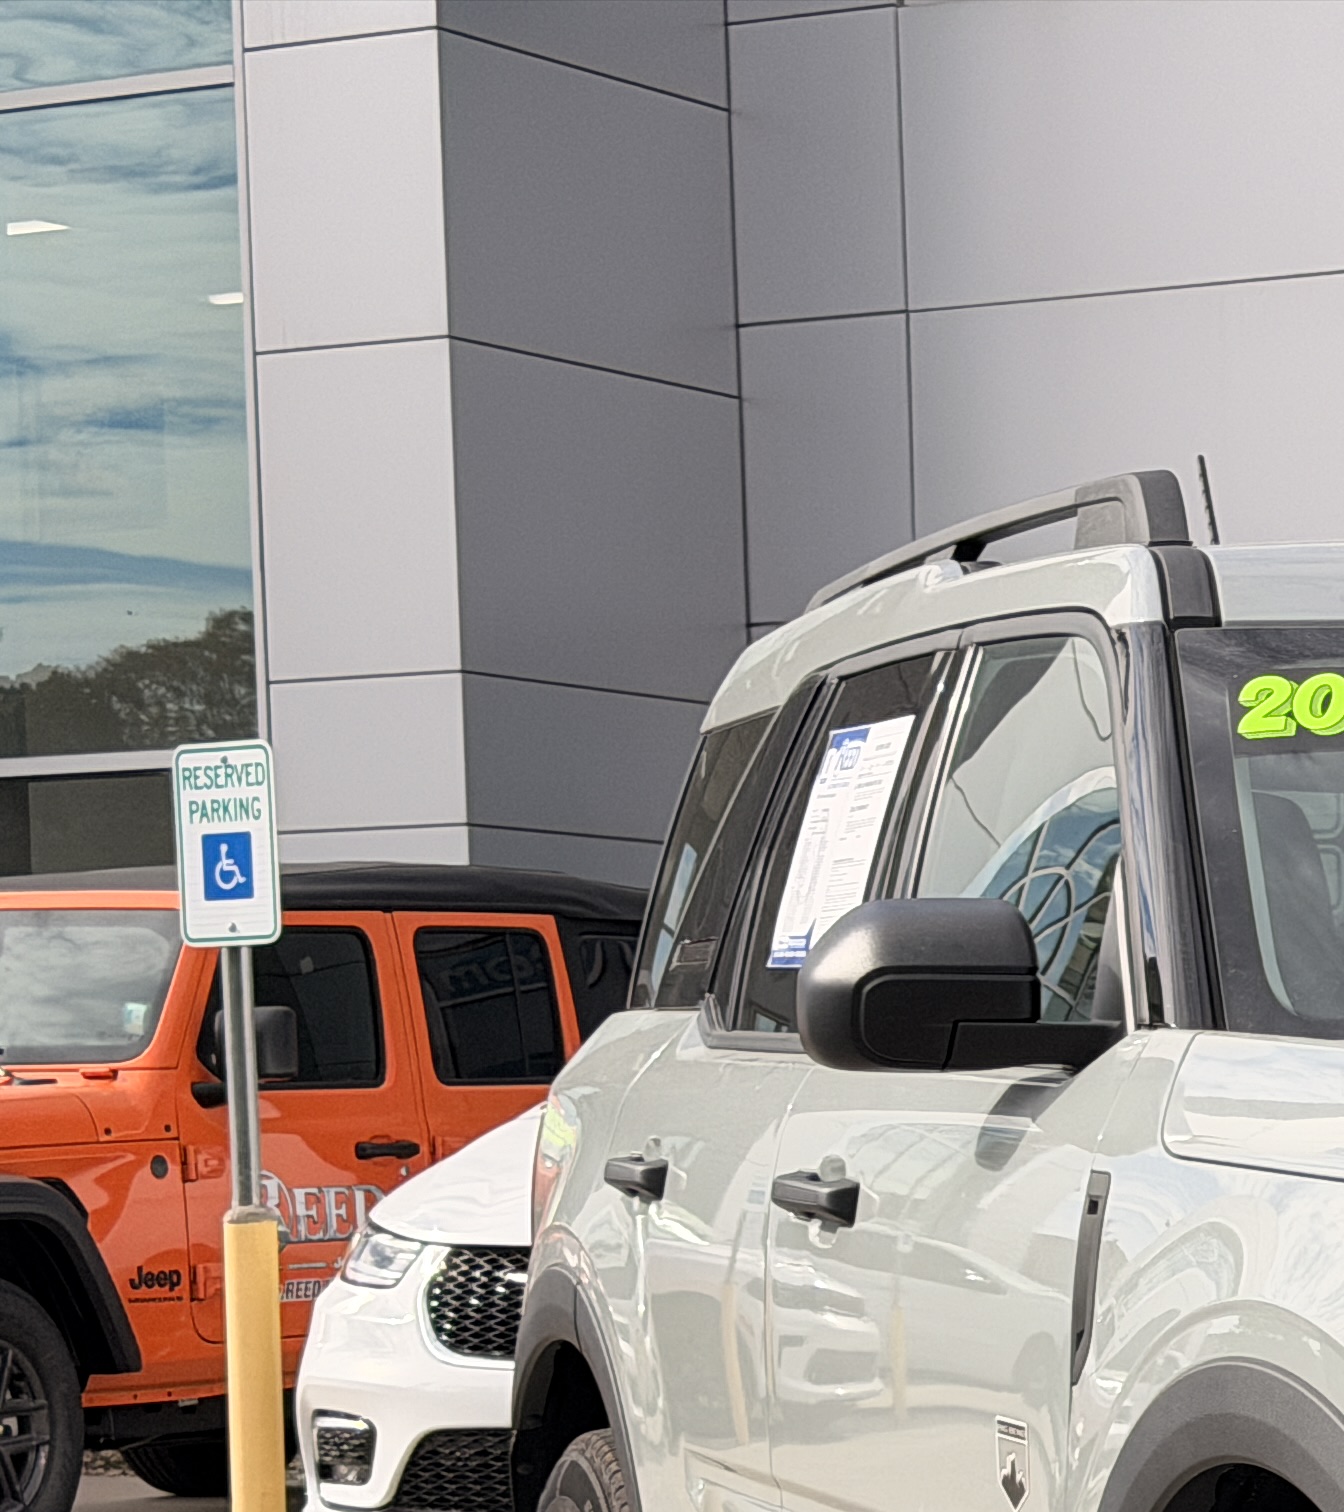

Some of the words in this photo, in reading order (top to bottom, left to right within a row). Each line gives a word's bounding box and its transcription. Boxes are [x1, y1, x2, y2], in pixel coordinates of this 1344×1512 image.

[182, 762, 265, 790] RESERVED
[188, 796, 261, 824] PARKING
[129, 1265, 182, 1292] Jeep
